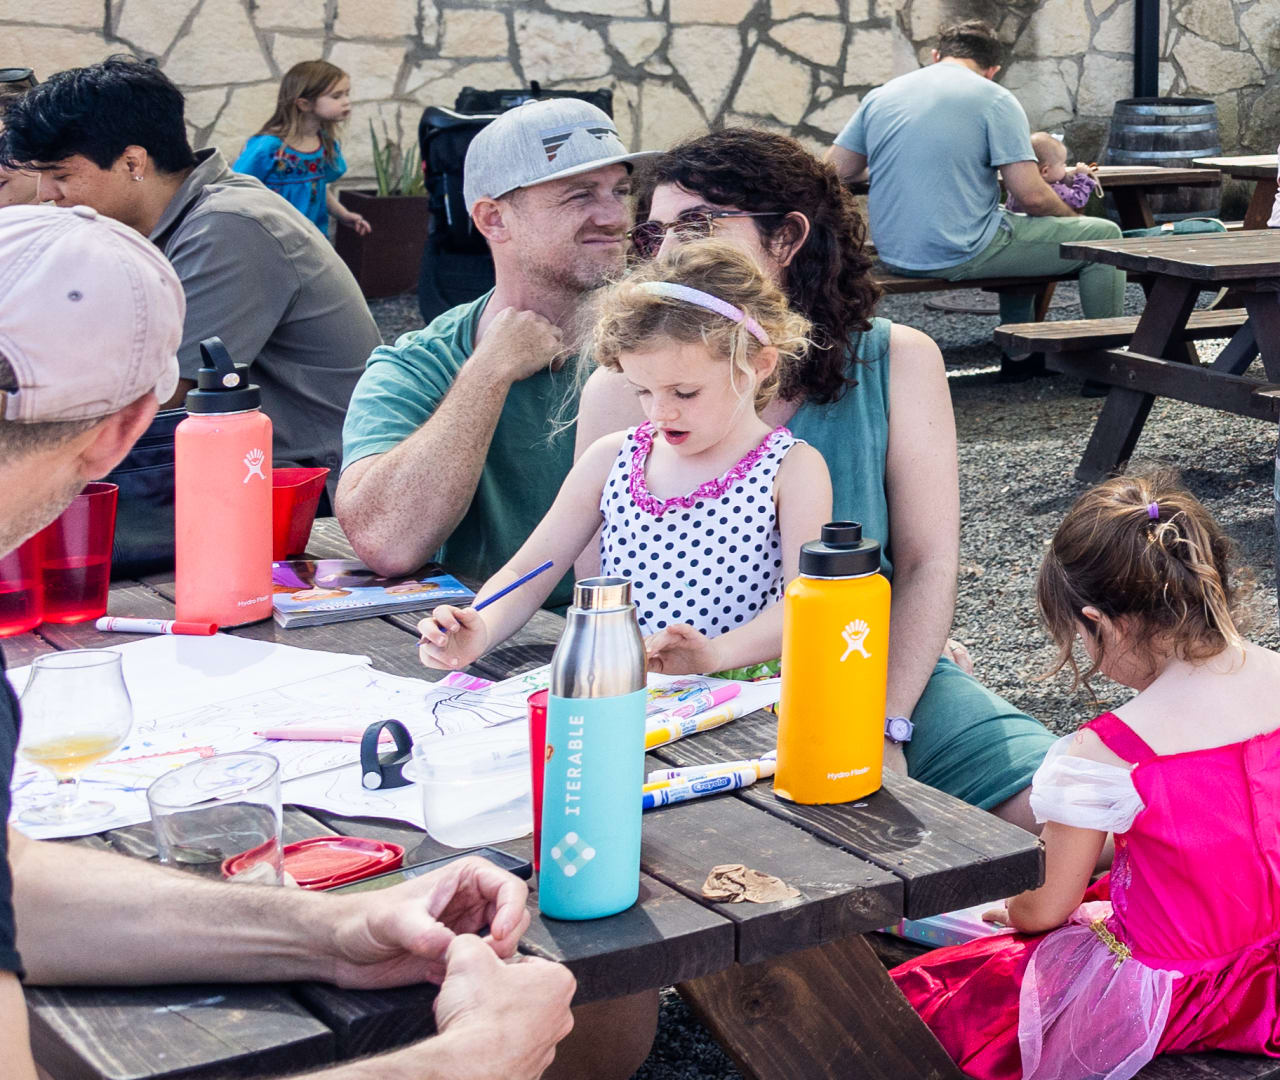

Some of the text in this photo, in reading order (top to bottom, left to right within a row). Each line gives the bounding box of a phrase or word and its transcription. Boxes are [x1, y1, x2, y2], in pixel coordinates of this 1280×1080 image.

[565, 715, 584, 816] ITERABLE
[826, 771, 850, 781] Hydro
[694, 778, 727, 790] Crayola
